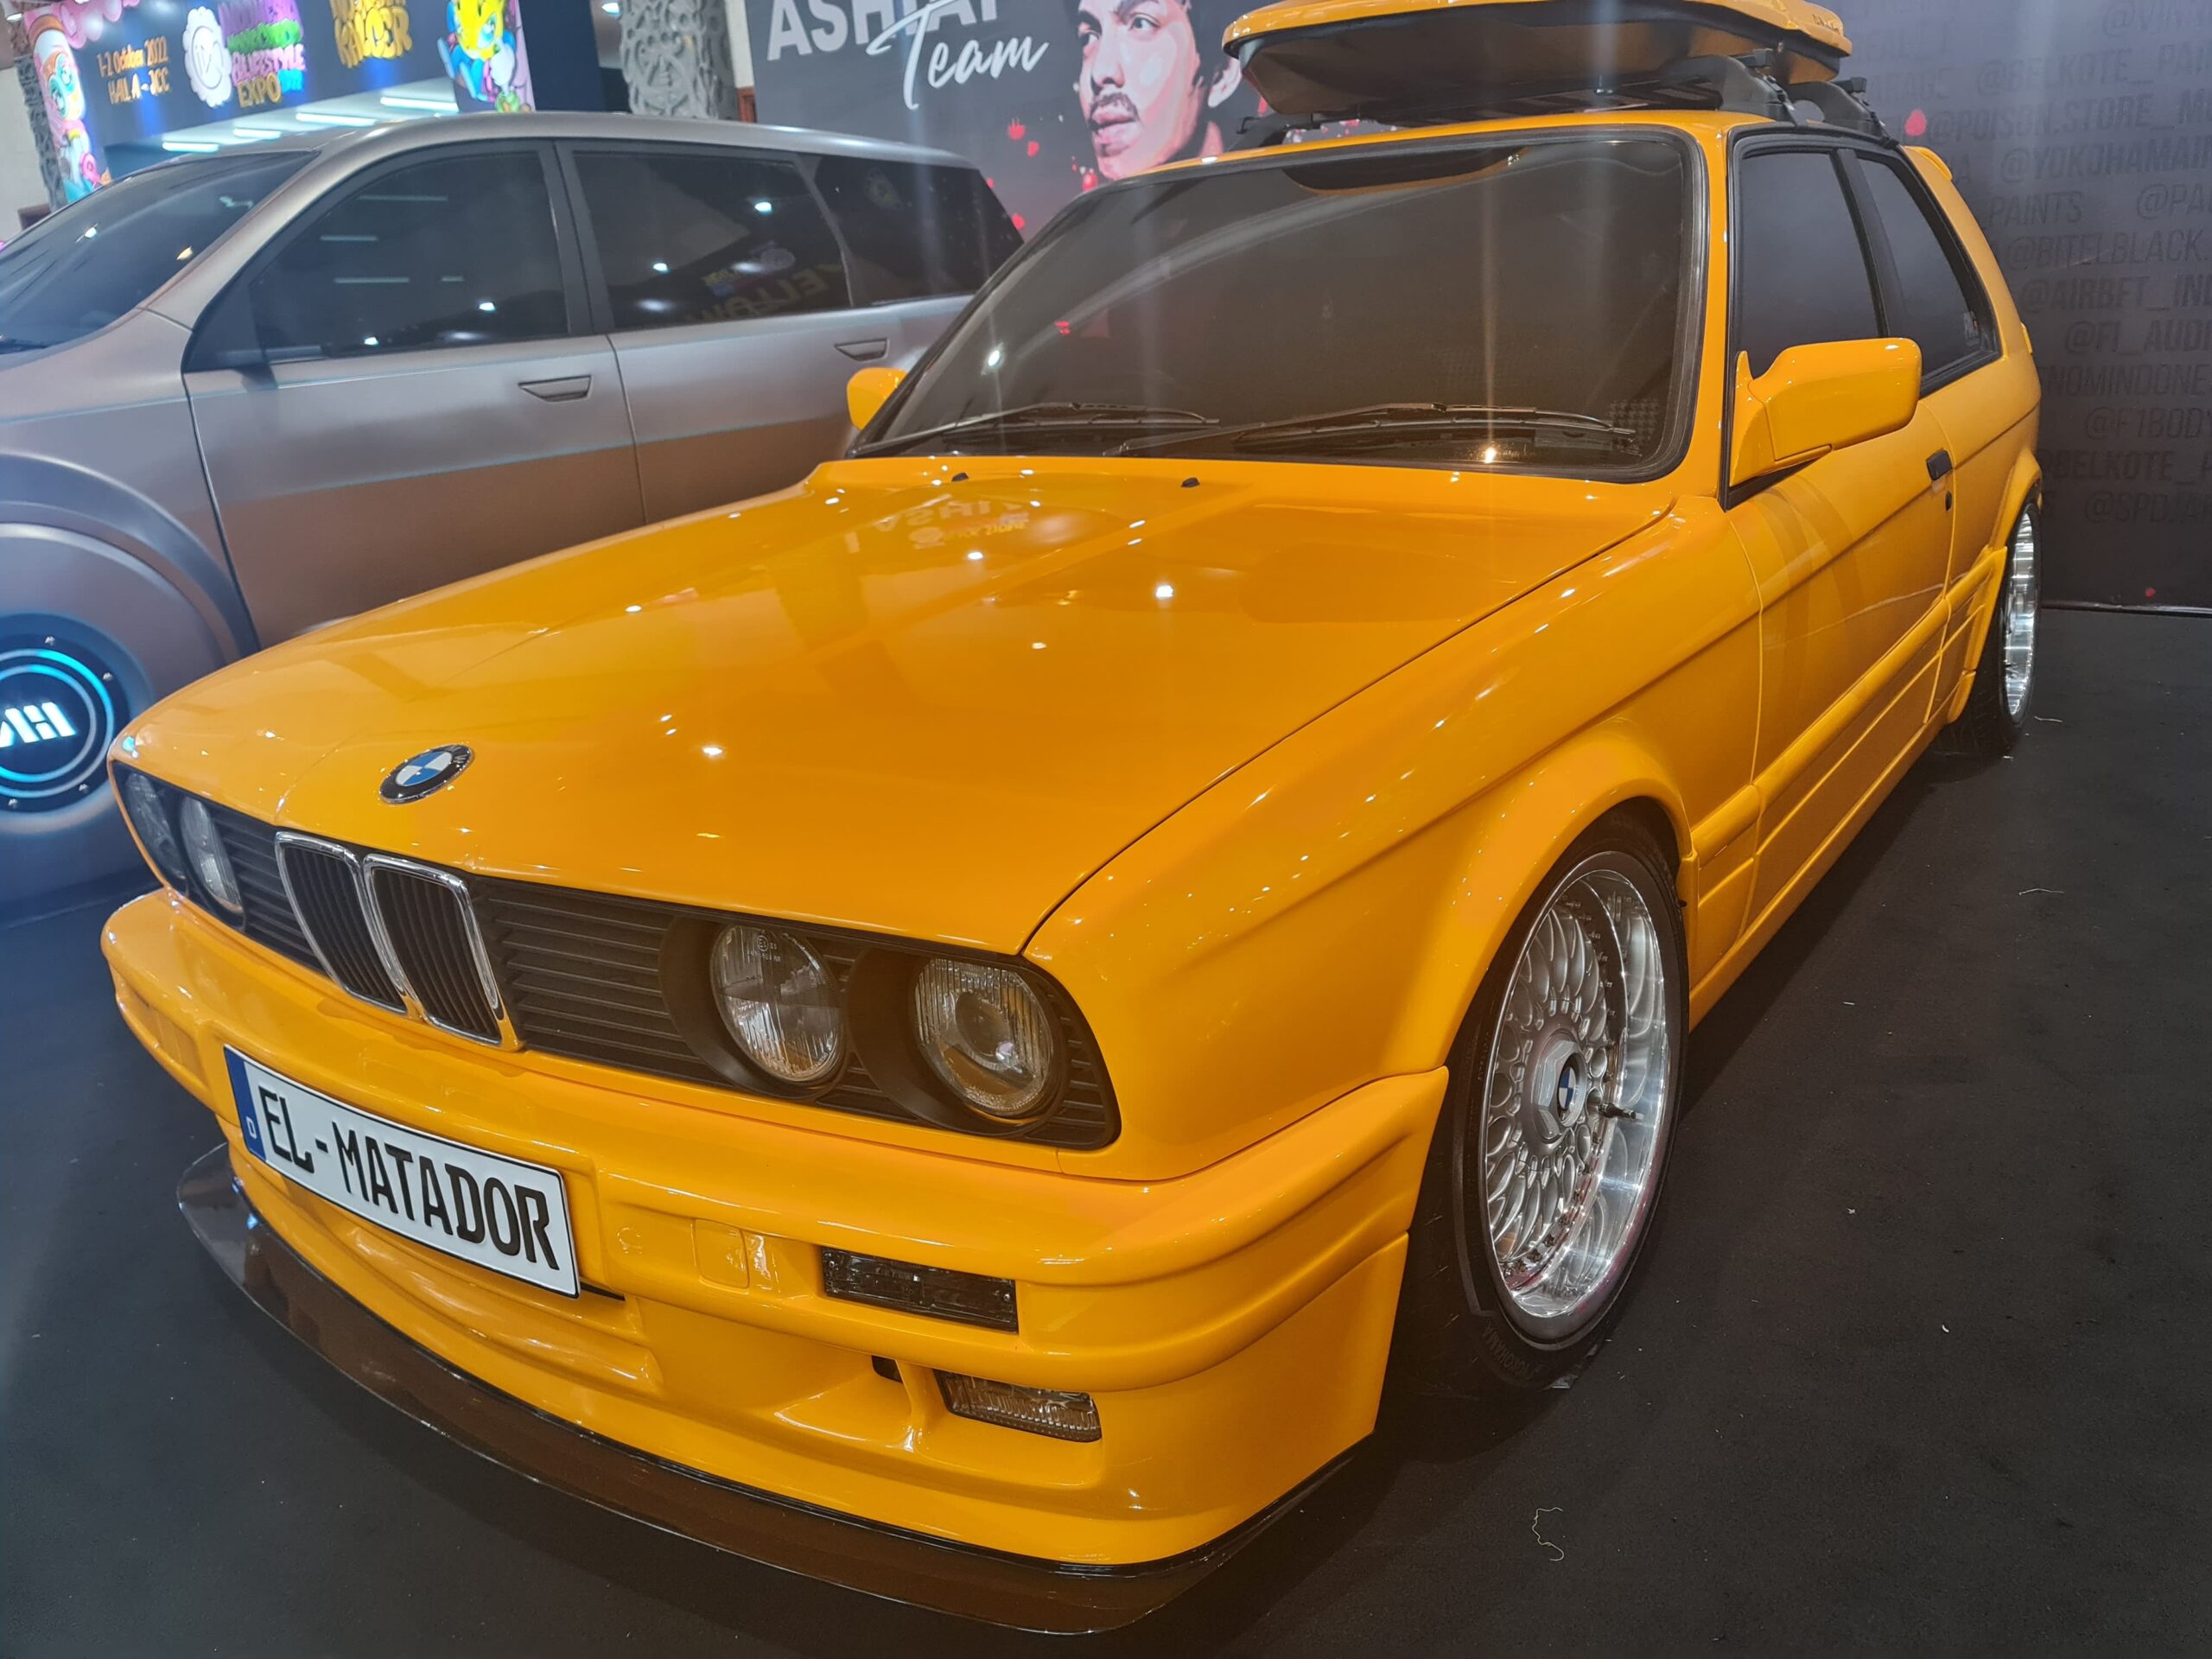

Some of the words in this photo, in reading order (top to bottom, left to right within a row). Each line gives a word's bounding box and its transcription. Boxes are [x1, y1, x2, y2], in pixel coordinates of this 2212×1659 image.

[767, 0, 998, 61] ASHI
[866, 0, 1049, 110] Team
[237, 72, 283, 108] EXPO
[2136, 181, 2212, 220] @PA
[2086, 406, 2212, 440] @F1BOD
[245, 1116, 257, 1140] D
[257, 1085, 560, 1271] EL-MATADOR
